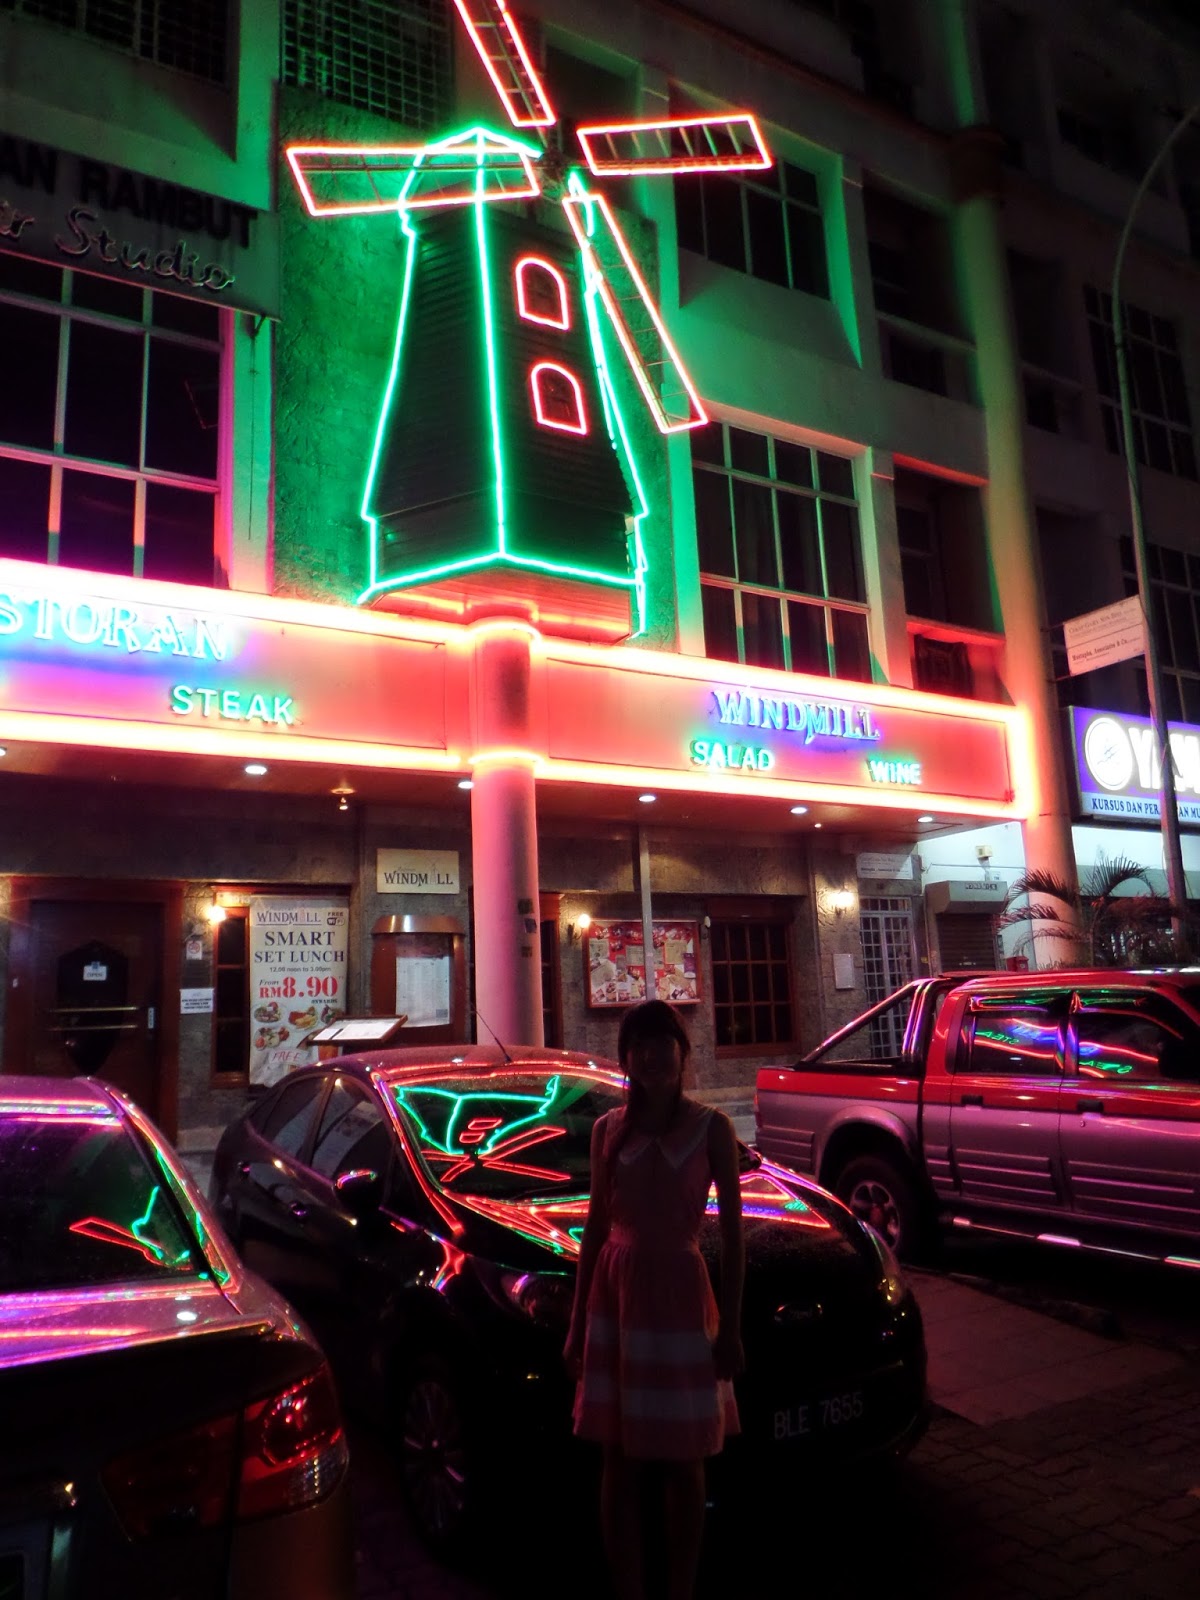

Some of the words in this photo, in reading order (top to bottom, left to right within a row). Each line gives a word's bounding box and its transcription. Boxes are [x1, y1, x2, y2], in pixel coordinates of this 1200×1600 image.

[81, 160, 258, 248] RAMBUT
[55, 205, 235, 291] Studio
[172, 684, 294, 726] STEAK
[711, 688, 881, 745] WINDMILL
[690, 739, 775, 772] SALAD
[867, 759, 922, 785] WINE
[1092, 798, 1125, 812] KURSUS
[1126, 800, 1143, 814] DAN
[384, 870, 454, 887] WINDMILL
[264, 931, 336, 946] SMART
[254, 950, 285, 963] SET
[290, 950, 345, 963] LUNCH
[259, 978, 279, 986] From
[774, 1405, 811, 1440] BLE
[819, 1391, 864, 1428] 7655
